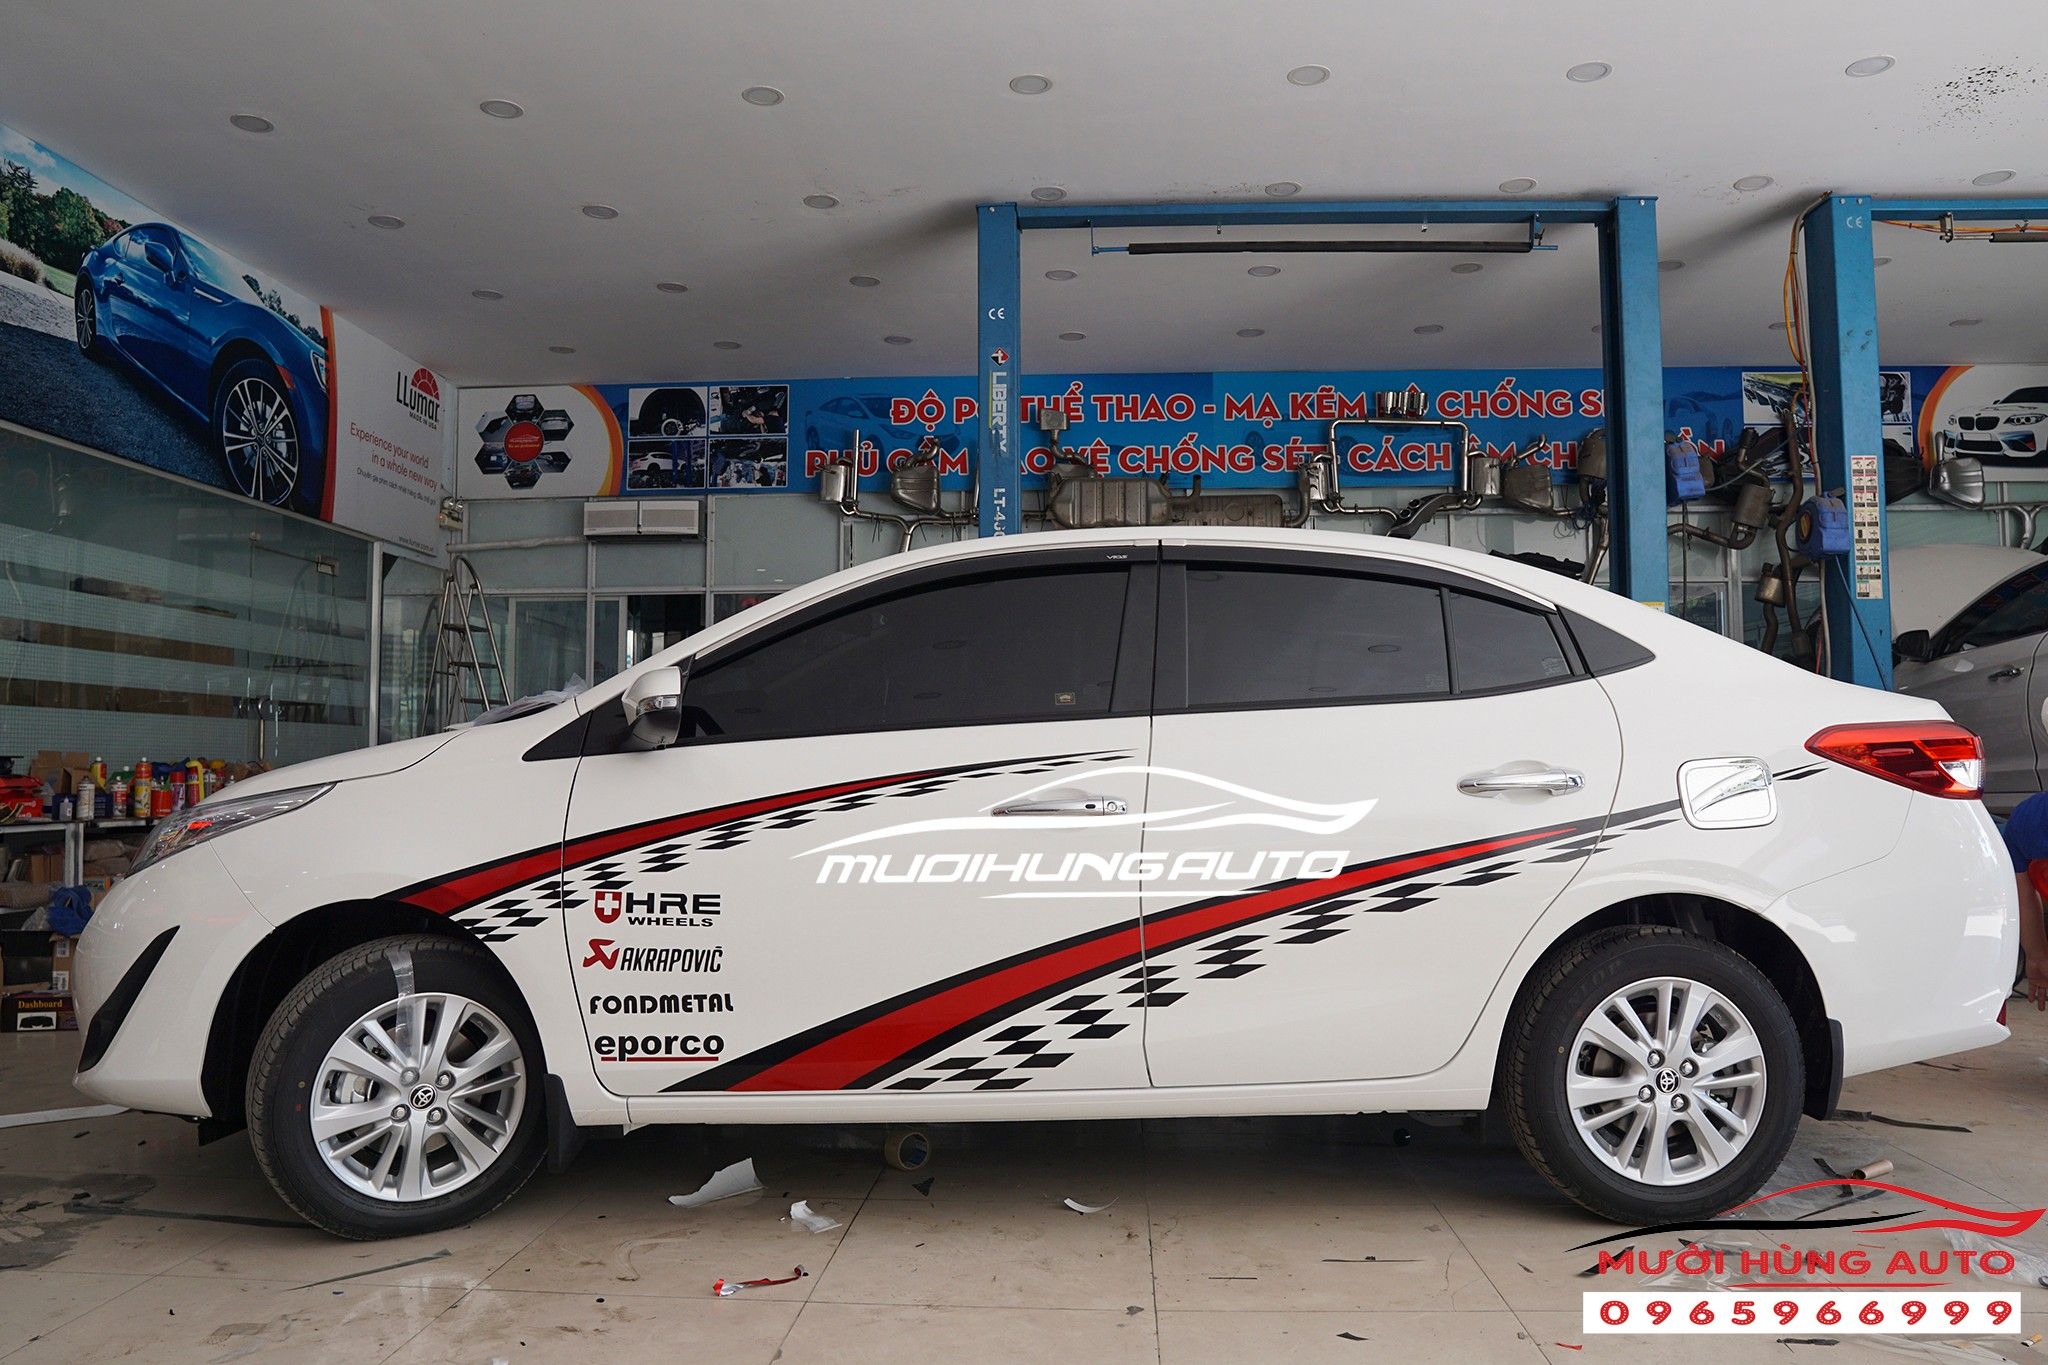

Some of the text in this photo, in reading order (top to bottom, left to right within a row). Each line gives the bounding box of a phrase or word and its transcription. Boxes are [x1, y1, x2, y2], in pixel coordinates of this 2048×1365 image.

[396, 371, 440, 422] LLumar
[890, 388, 946, 432] ĐỘ
[1091, 393, 1196, 423] THAO
[1223, 392, 1283, 428] MẠ
[1288, 385, 1367, 421] KẼM
[1435, 377, 1574, 419] CHỐNG
[991, 371, 1008, 453] LIBERTY
[350, 421, 429, 469] Experience your world
[1117, 432, 1256, 474] CHỐNG
[1347, 435, 1453, 472] CÁCH
[386, 459, 408, 478] whole
[408, 470, 424, 485] new
[423, 476, 438, 493] way
[625, 892, 721, 915] HRE
[628, 916, 714, 927] WHEELS
[18, 999, 63, 1009] Dashboard
[589, 993, 734, 1015] FONDMETAL
[594, 1035, 724, 1062] eporco
